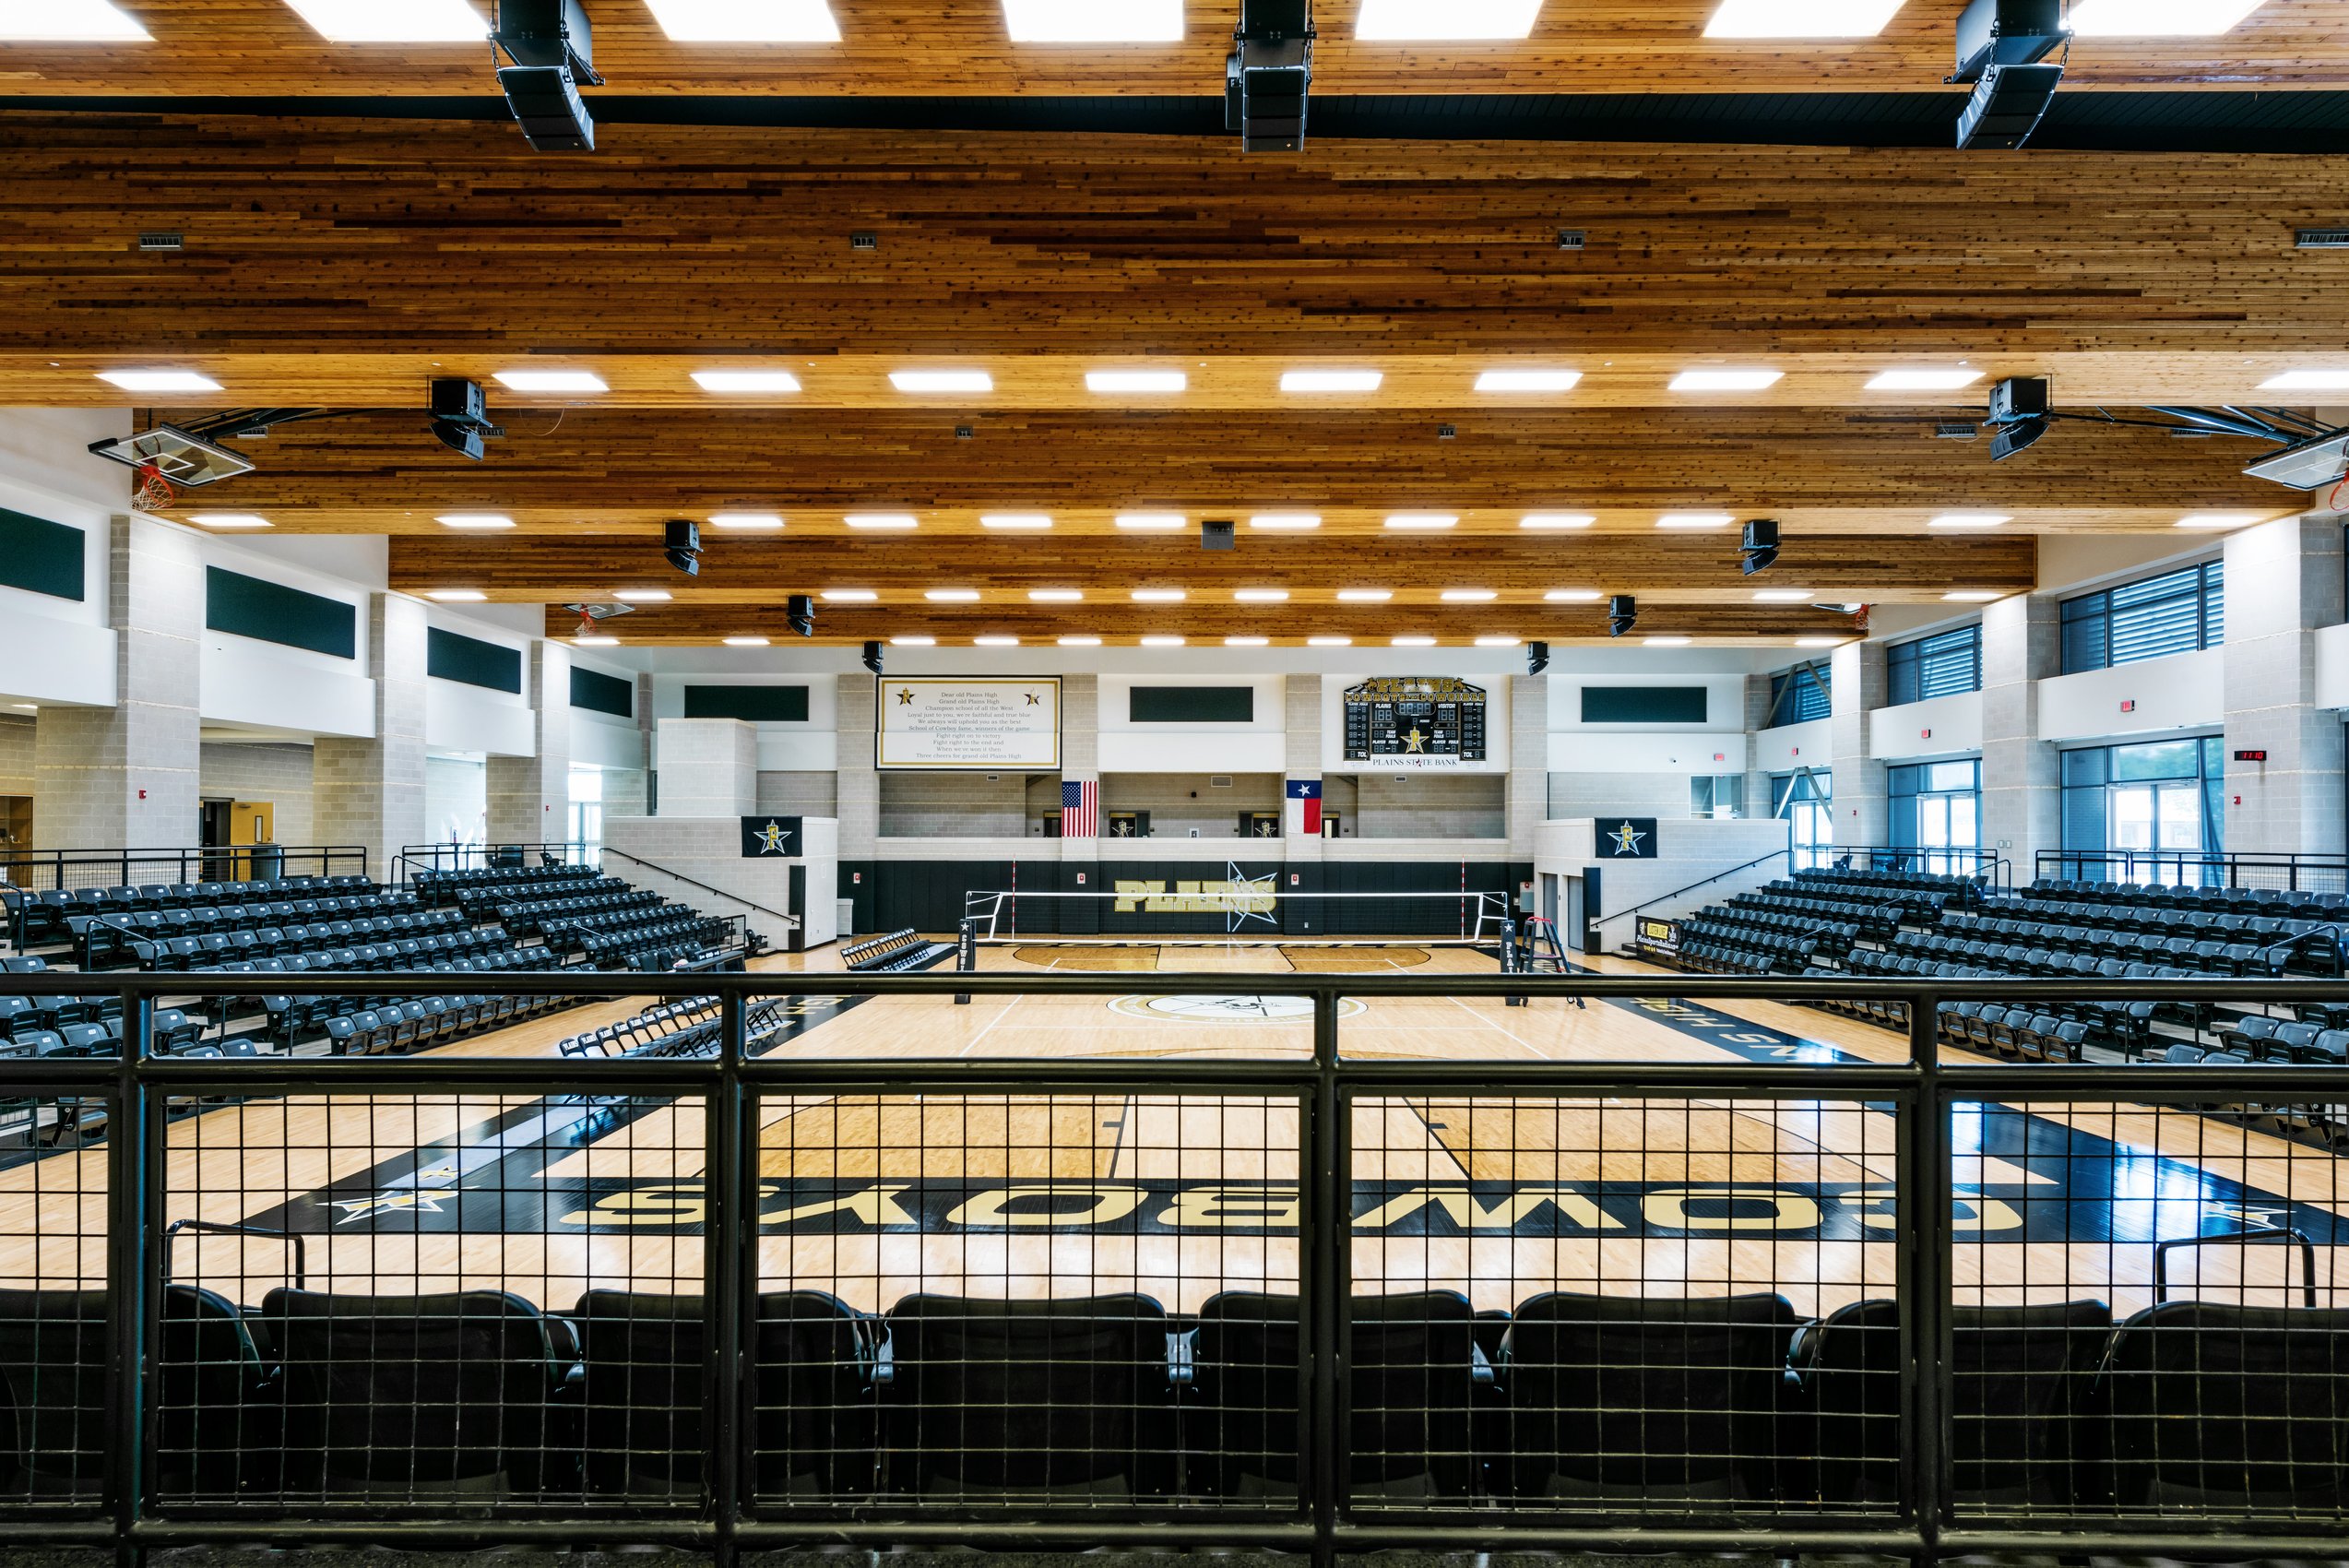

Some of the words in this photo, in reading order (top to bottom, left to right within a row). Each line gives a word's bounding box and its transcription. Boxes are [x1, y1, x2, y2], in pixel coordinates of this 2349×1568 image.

[1345, 693, 1405, 702] COWBOYS
[1114, 880, 1276, 912] PLAINS
[1506, 942, 1514, 973] PLAI
[559, 1184, 2023, 1230] COWBOYS
